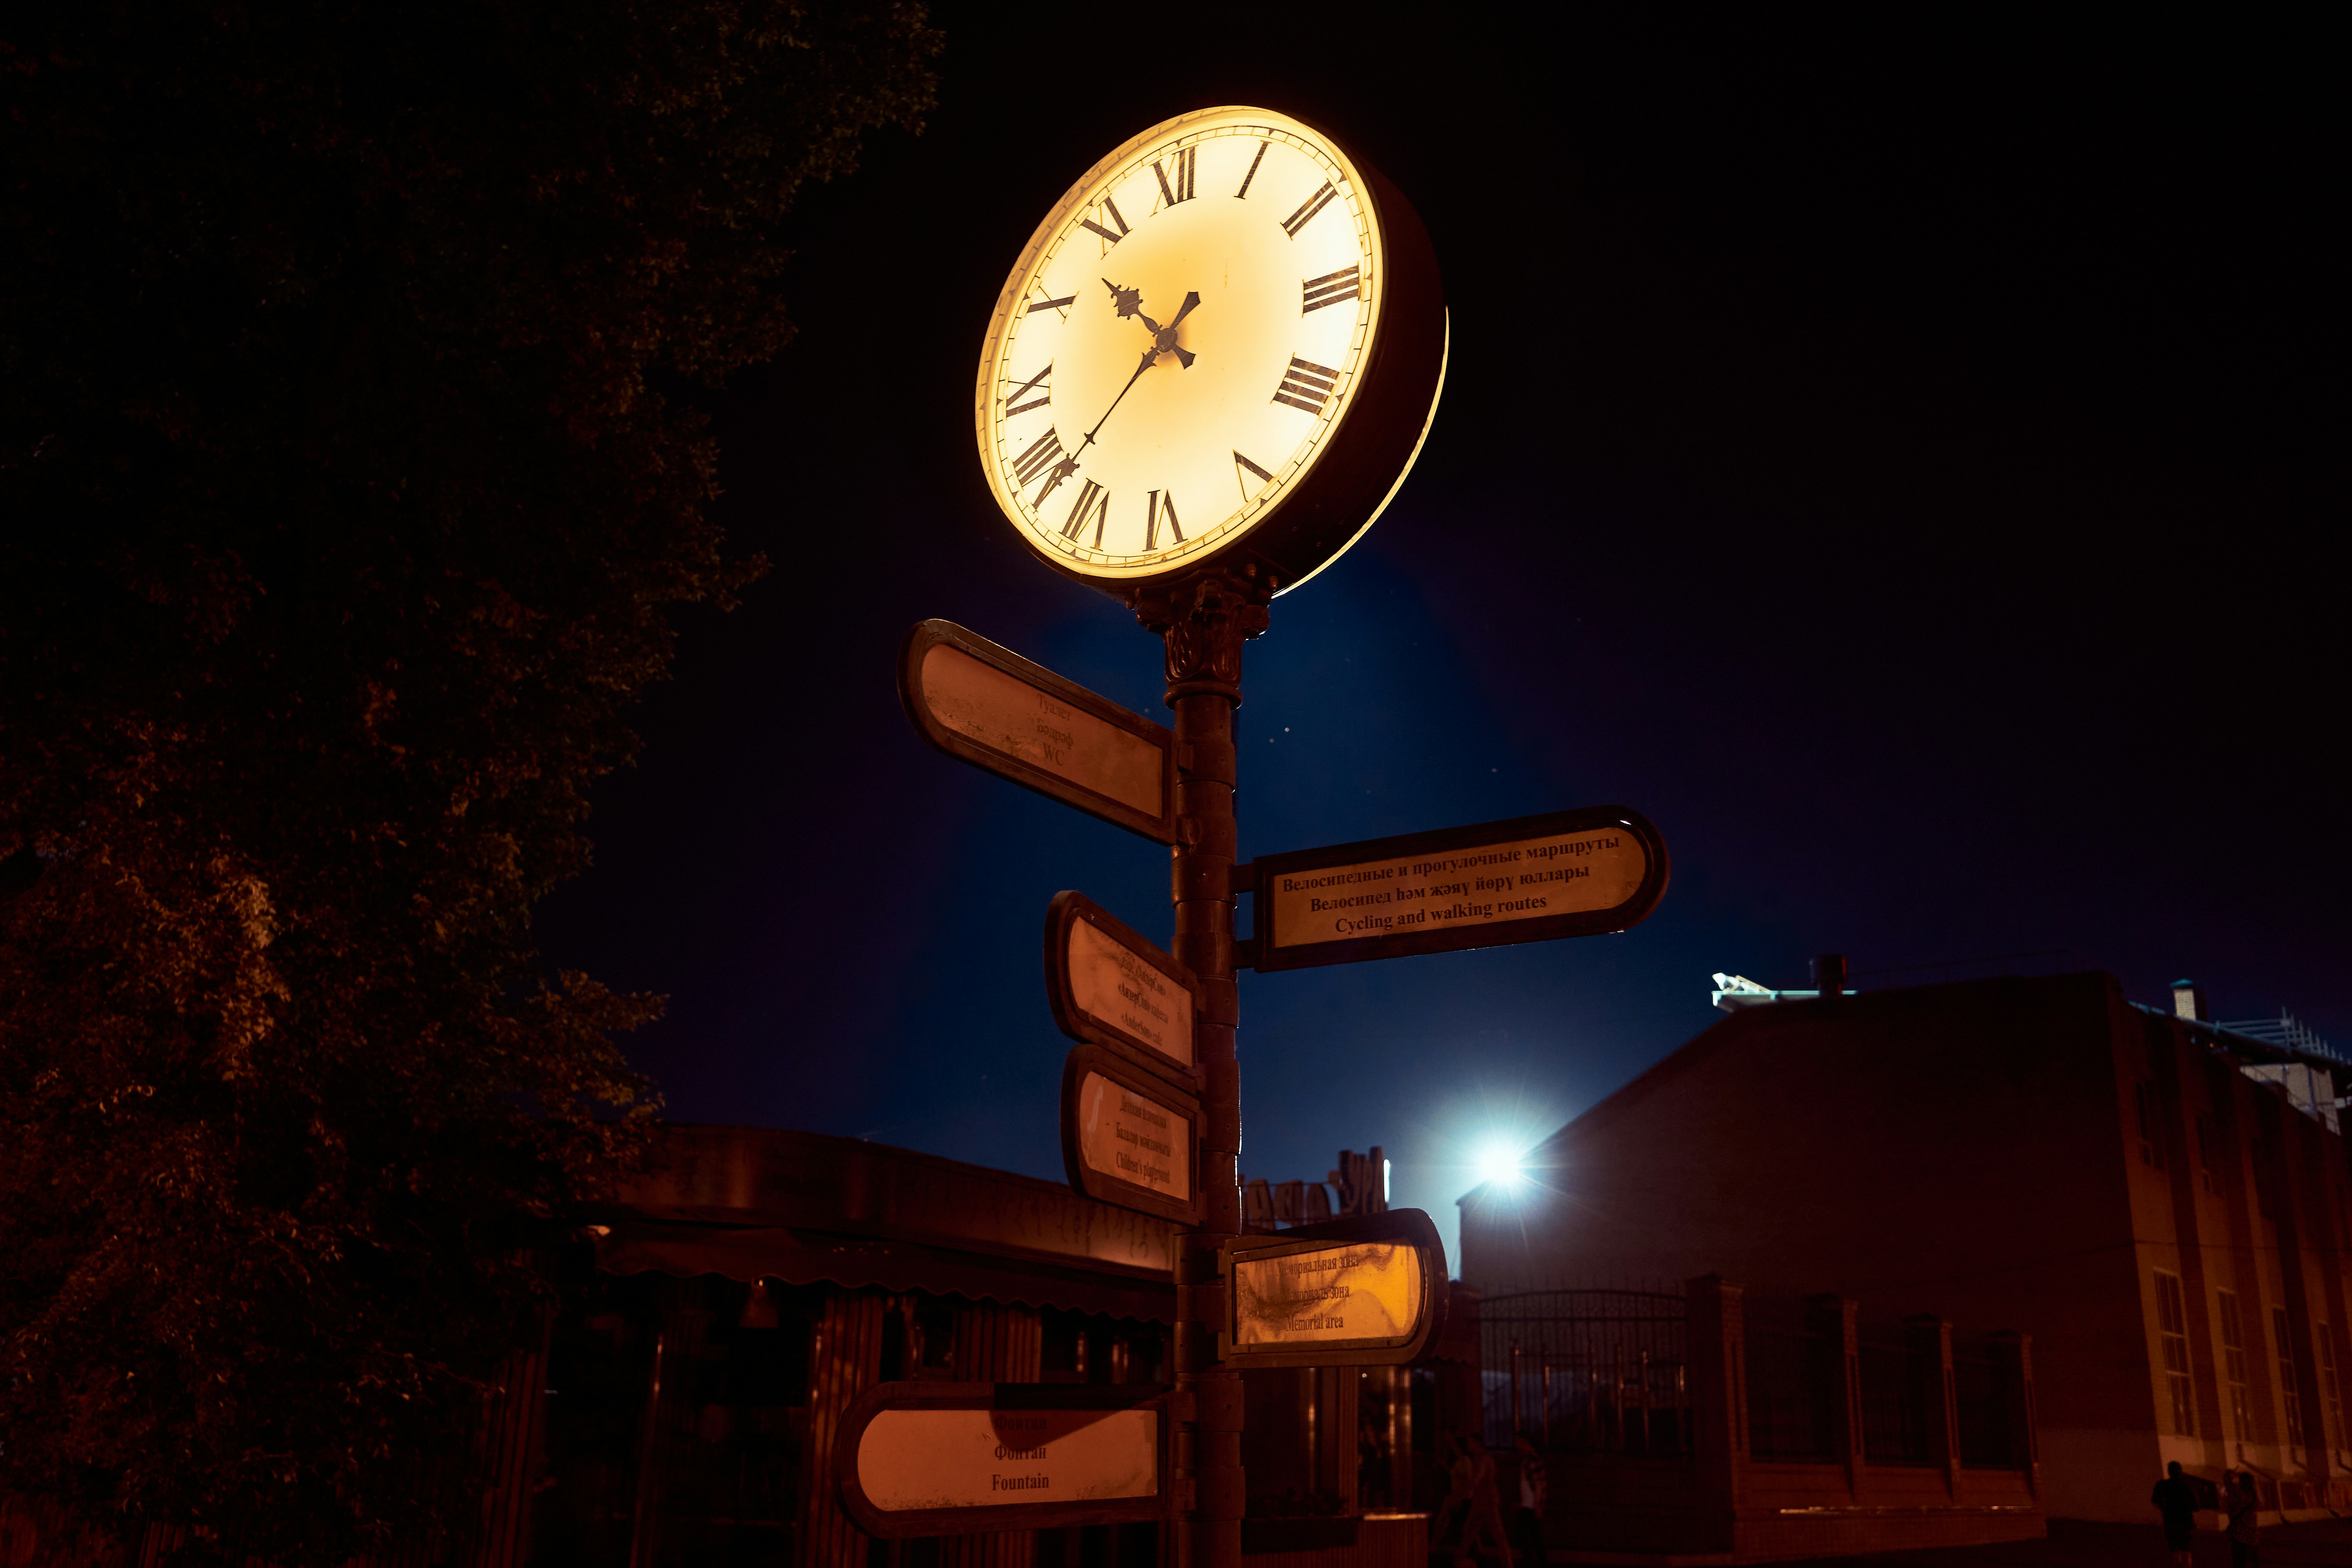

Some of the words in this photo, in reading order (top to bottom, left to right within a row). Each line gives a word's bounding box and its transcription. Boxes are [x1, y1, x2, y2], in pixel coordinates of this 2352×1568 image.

[1150, 144, 1198, 217] XII
[1234, 141, 1272, 200] I
[1078, 193, 1133, 260] XI
[1280, 178, 1340, 241] II
[1025, 280, 1080, 324] X
[1302, 261, 1361, 318] III
[1005, 358, 1054, 421] IX
[1270, 352, 1342, 418] IIII
[1232, 449, 1275, 503] V
[1058, 477, 1110, 551] VII
[1142, 489, 1189, 553] VI
[1037, 693, 1071, 721] Туалет
[1043, 742, 1064, 766] WC
[1283, 868, 1393, 893] Велосипедные
[1398, 866, 1408, 876] и
[1412, 850, 1521, 877] прогулочные
[1526, 837, 1620, 860] маршруты
[1311, 891, 1391, 912] Велосипед
[1475, 876, 1514, 892] йөрү
[1520, 866, 1589, 883] юллары
[1335, 915, 1393, 935] Cycling
[1397, 909, 1425, 925] and
[1430, 901, 1493, 921] walking
[1497, 895, 1547, 913] routes
[1143, 1161, 1170, 1184] playground
[1338, 1255, 1358, 1268] зона
[1329, 1286, 1350, 1299] зона
[1287, 1313, 1323, 1331] Memorial
[1326, 1316, 1344, 1329] area
[994, 1414, 1047, 1431] Фонтан
[994, 1444, 1047, 1460] Фонтан
[992, 1472, 1049, 1491] Fountain
